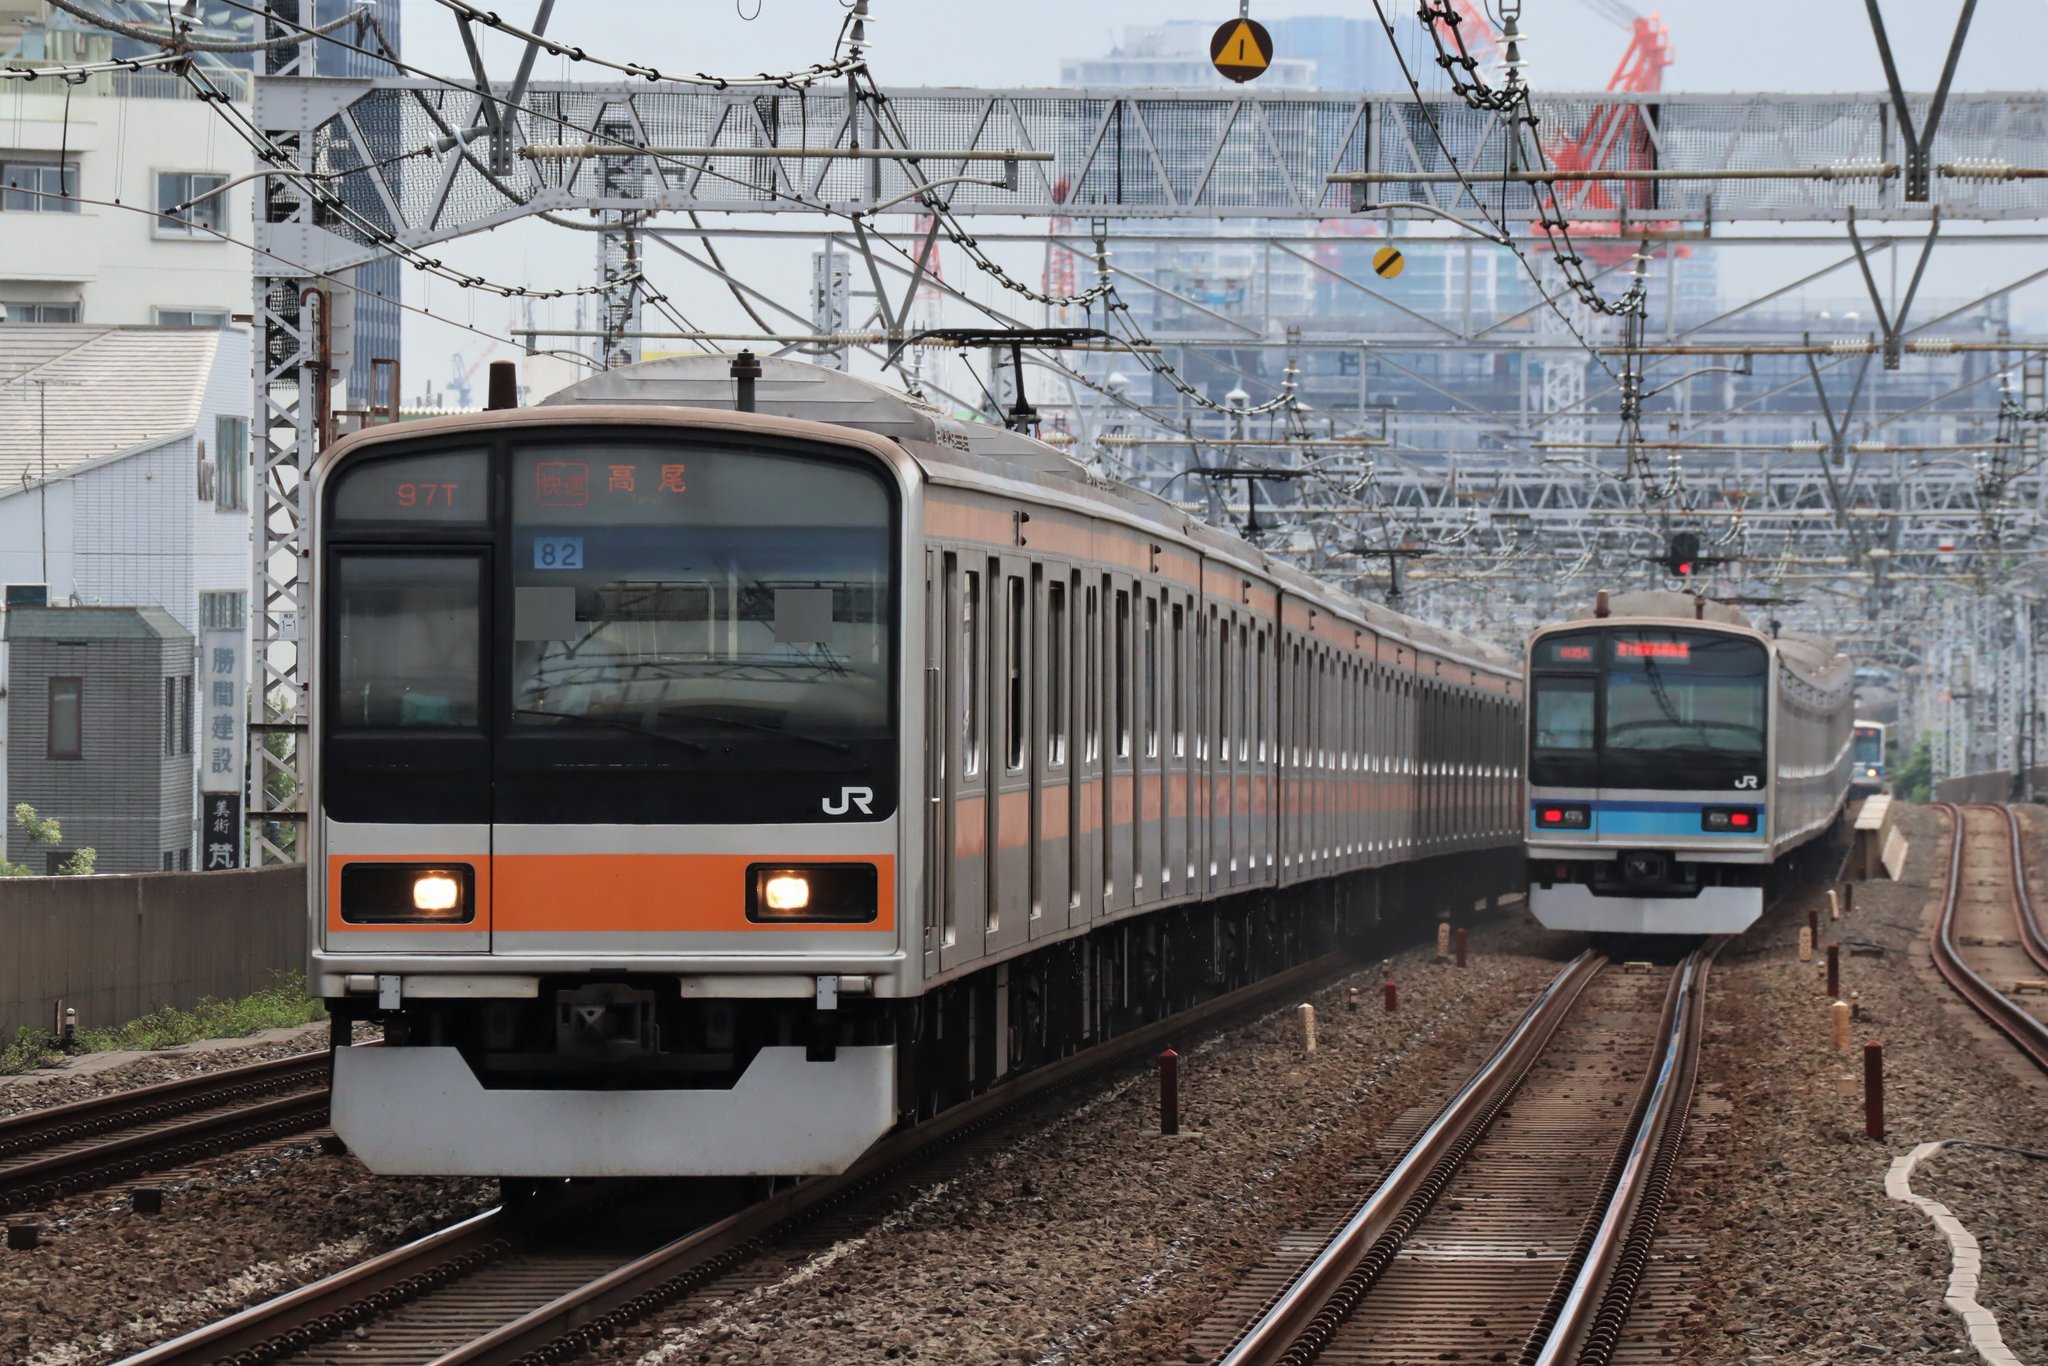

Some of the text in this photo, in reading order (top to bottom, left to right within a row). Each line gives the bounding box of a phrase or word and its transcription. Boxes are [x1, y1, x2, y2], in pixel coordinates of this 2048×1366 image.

[607, 463, 687, 493] 高尾
[398, 483, 459, 507] 97T
[541, 542, 577, 567] 82
[211, 646, 235, 774] 勝間建設
[1734, 775, 1758, 789] JR
[821, 786, 874, 816] JR
[213, 799, 231, 835] 美術
